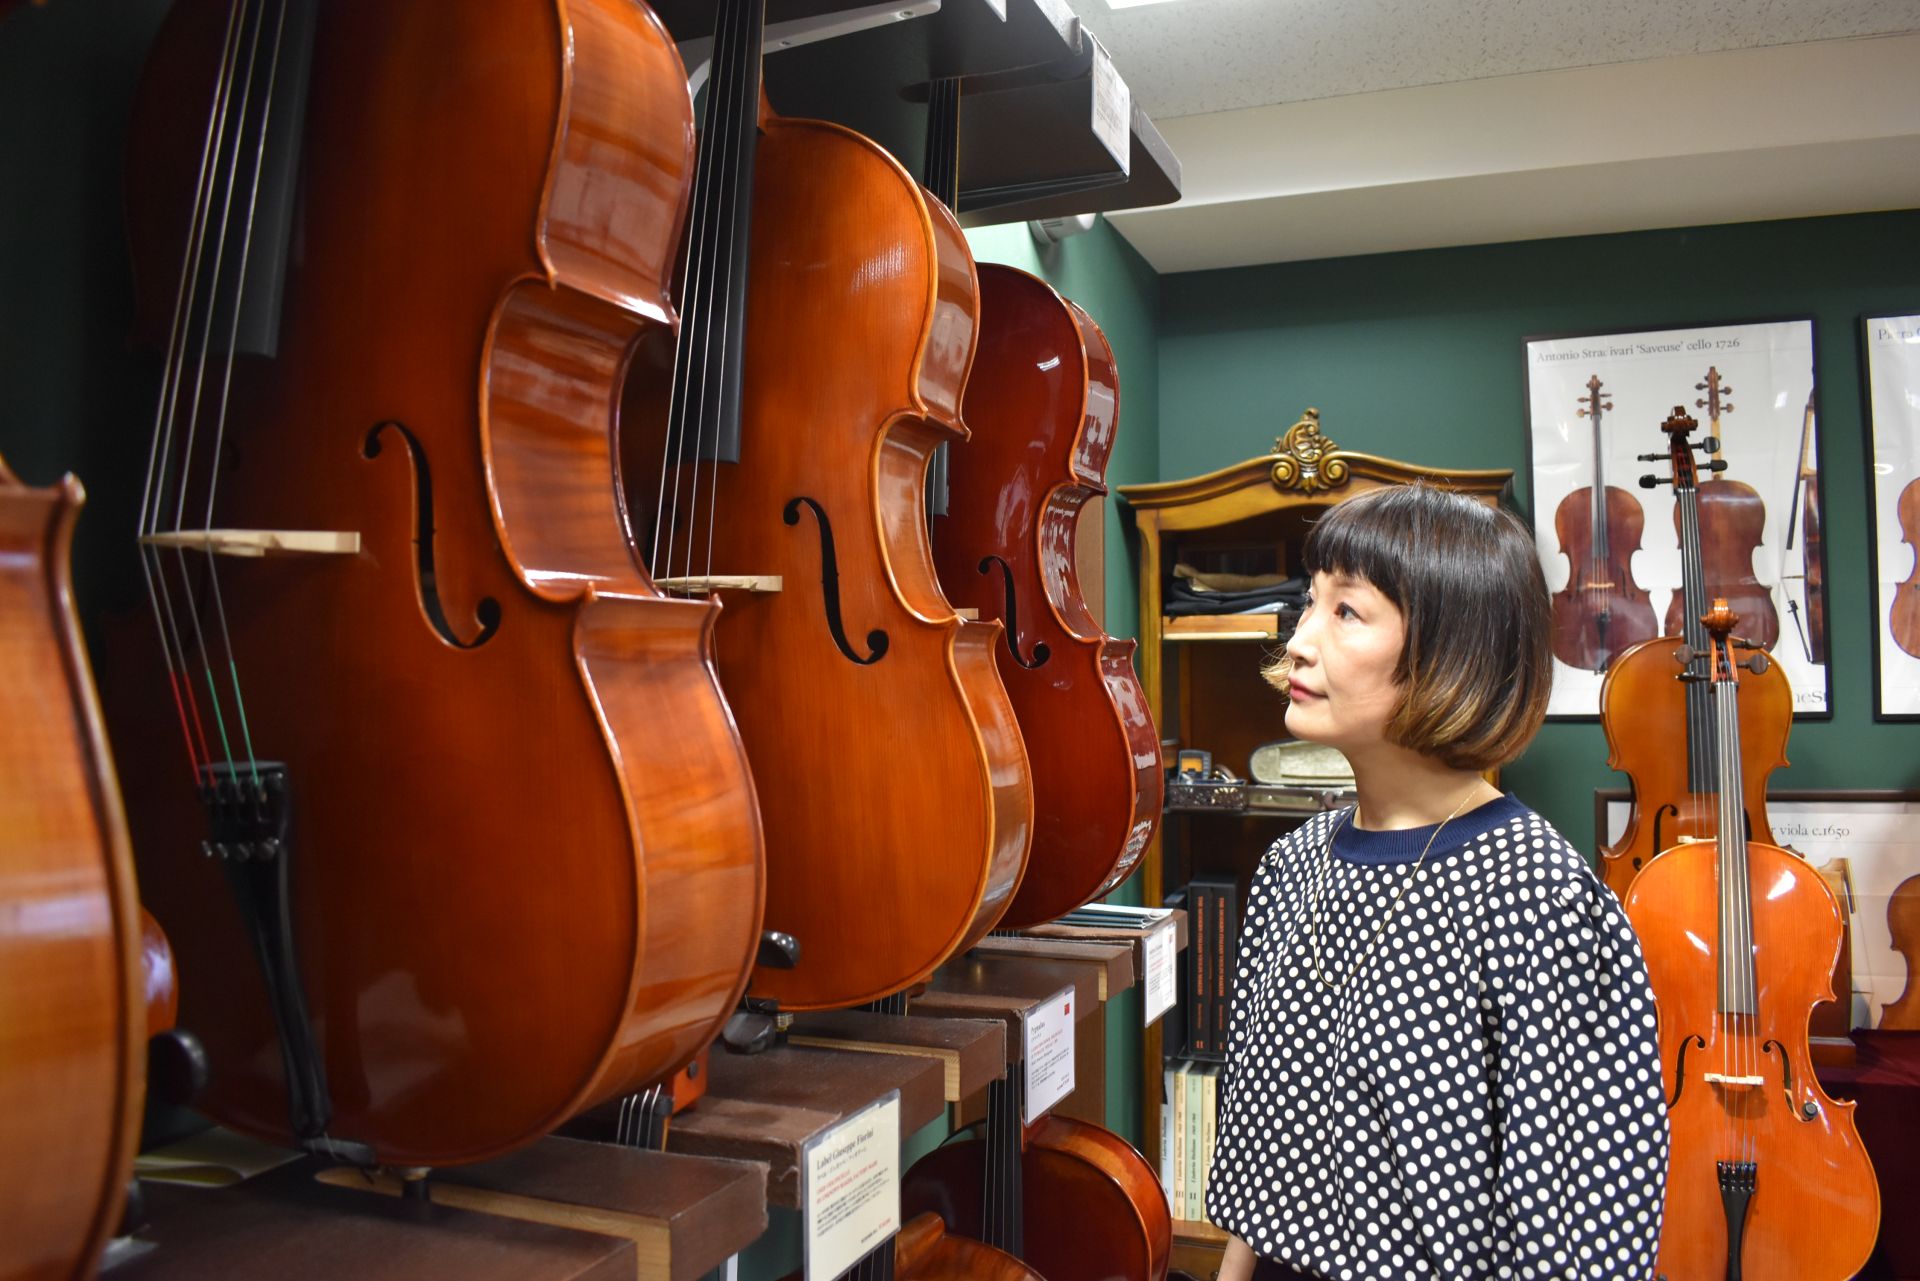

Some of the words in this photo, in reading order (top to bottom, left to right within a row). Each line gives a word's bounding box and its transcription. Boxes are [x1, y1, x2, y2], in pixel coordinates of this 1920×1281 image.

[1538, 350, 1579, 362] Antonio
[1687, 338, 1711, 351] cello
[1716, 337, 1741, 350] 1726
[1780, 823, 1808, 836] viola
[1812, 824, 1850, 840] c.1650
[817, 1151, 832, 1170] Label
